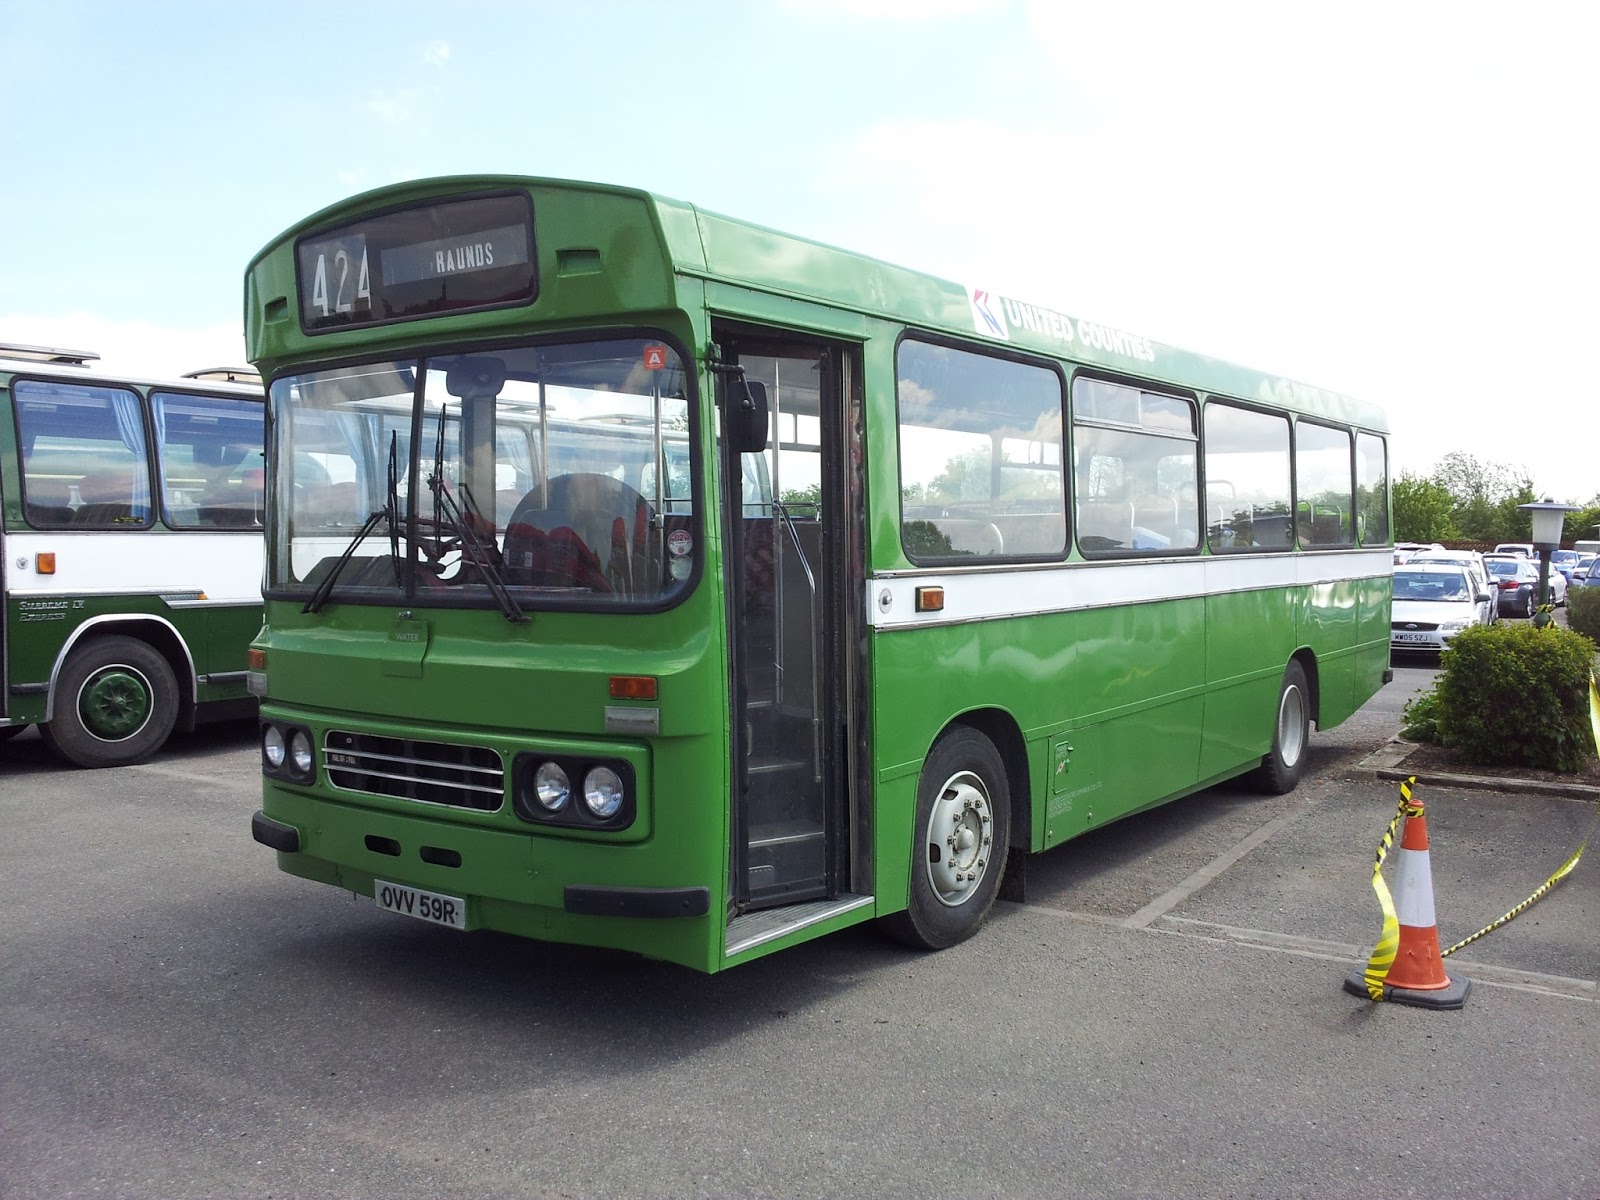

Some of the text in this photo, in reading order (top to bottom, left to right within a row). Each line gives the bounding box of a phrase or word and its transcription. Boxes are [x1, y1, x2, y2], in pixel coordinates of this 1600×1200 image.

[435, 242, 494, 273] RAUNDS
[313, 245, 372, 317] 424
[1003, 297, 1155, 363] UNITED COUNTIES
[649, 352, 661, 364] A
[396, 633, 419, 642] WATER
[382, 886, 455, 924] OVV 59R
